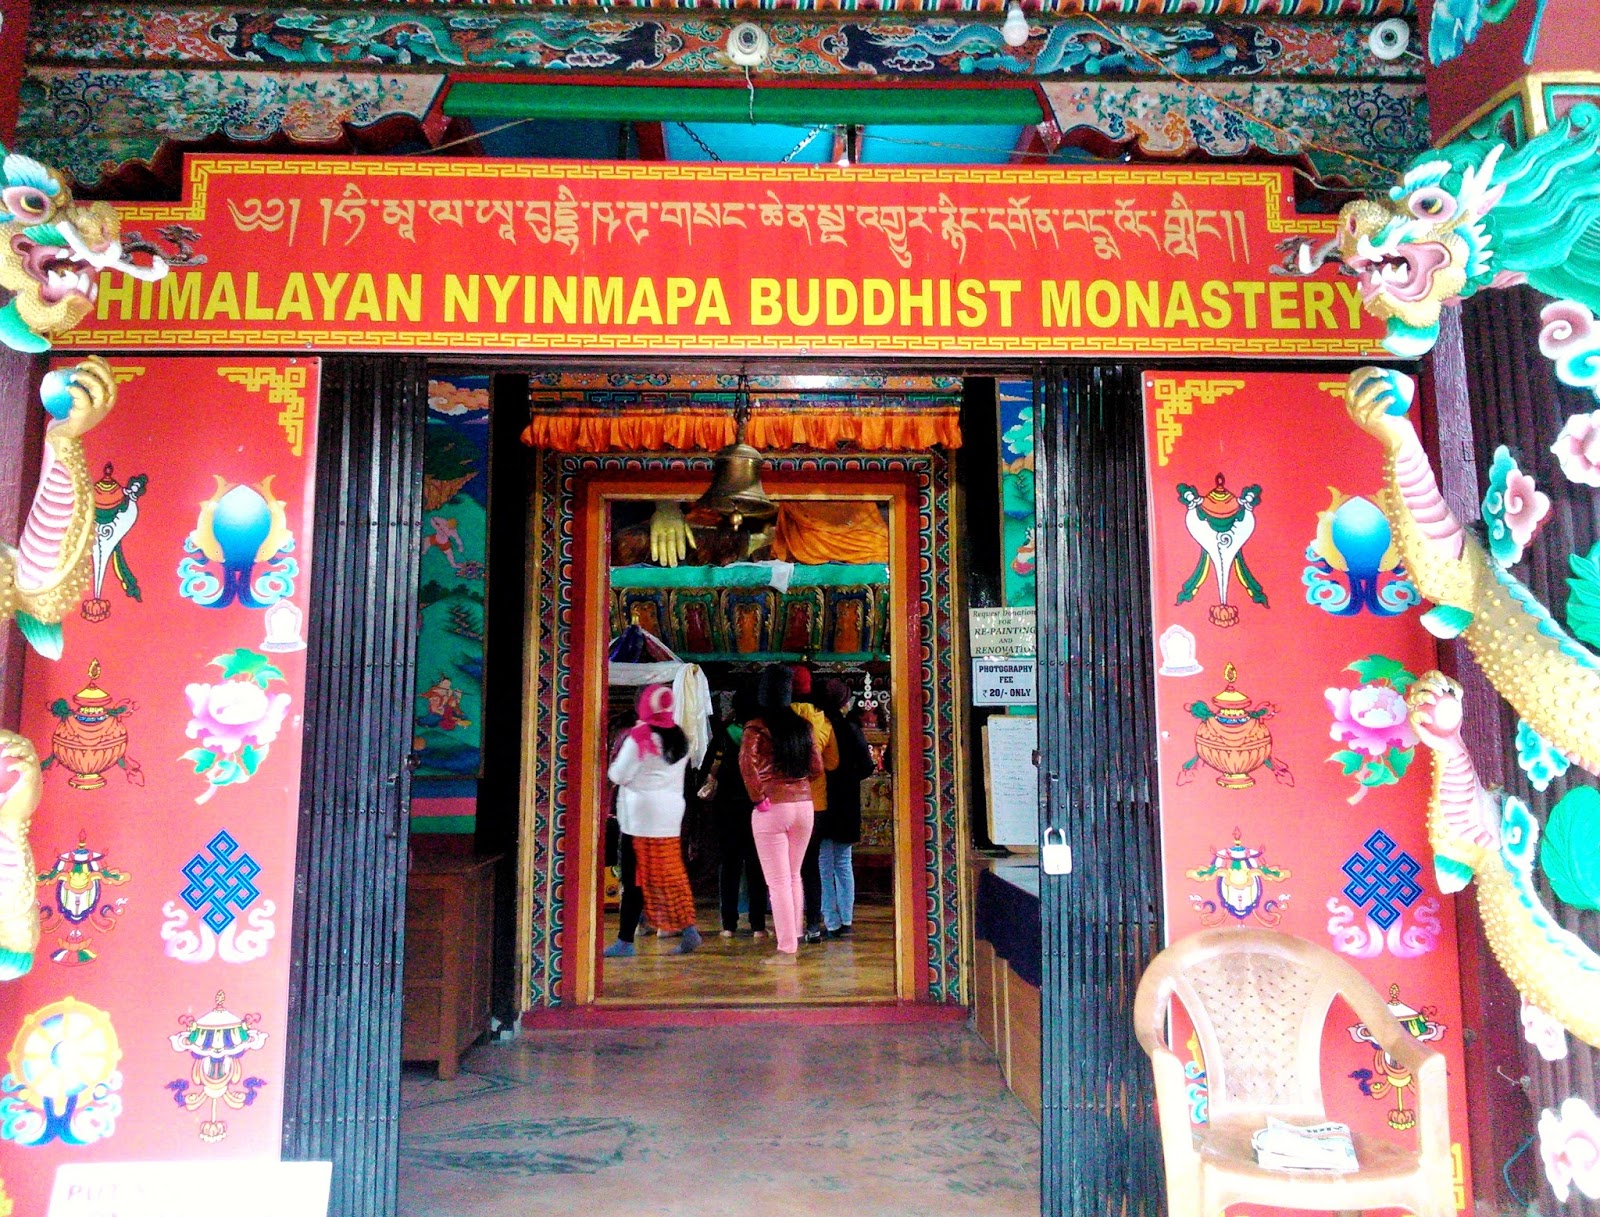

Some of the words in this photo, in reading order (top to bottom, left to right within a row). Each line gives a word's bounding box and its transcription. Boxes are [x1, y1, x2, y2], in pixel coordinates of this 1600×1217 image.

[96, 271, 422, 336] HIMALAYAN
[443, 273, 732, 327] NYINMAPA
[750, 276, 1022, 328] BUDDHIST
[1041, 279, 1364, 330] MONASTERY
[974, 626, 1036, 636] RE-PAINTING
[978, 665, 1033, 673] PHOTOGRAPHY
[999, 676, 1014, 684] FEE
[989, 688, 1008, 699] 20/-
[1010, 688, 1031, 697] ONLY
